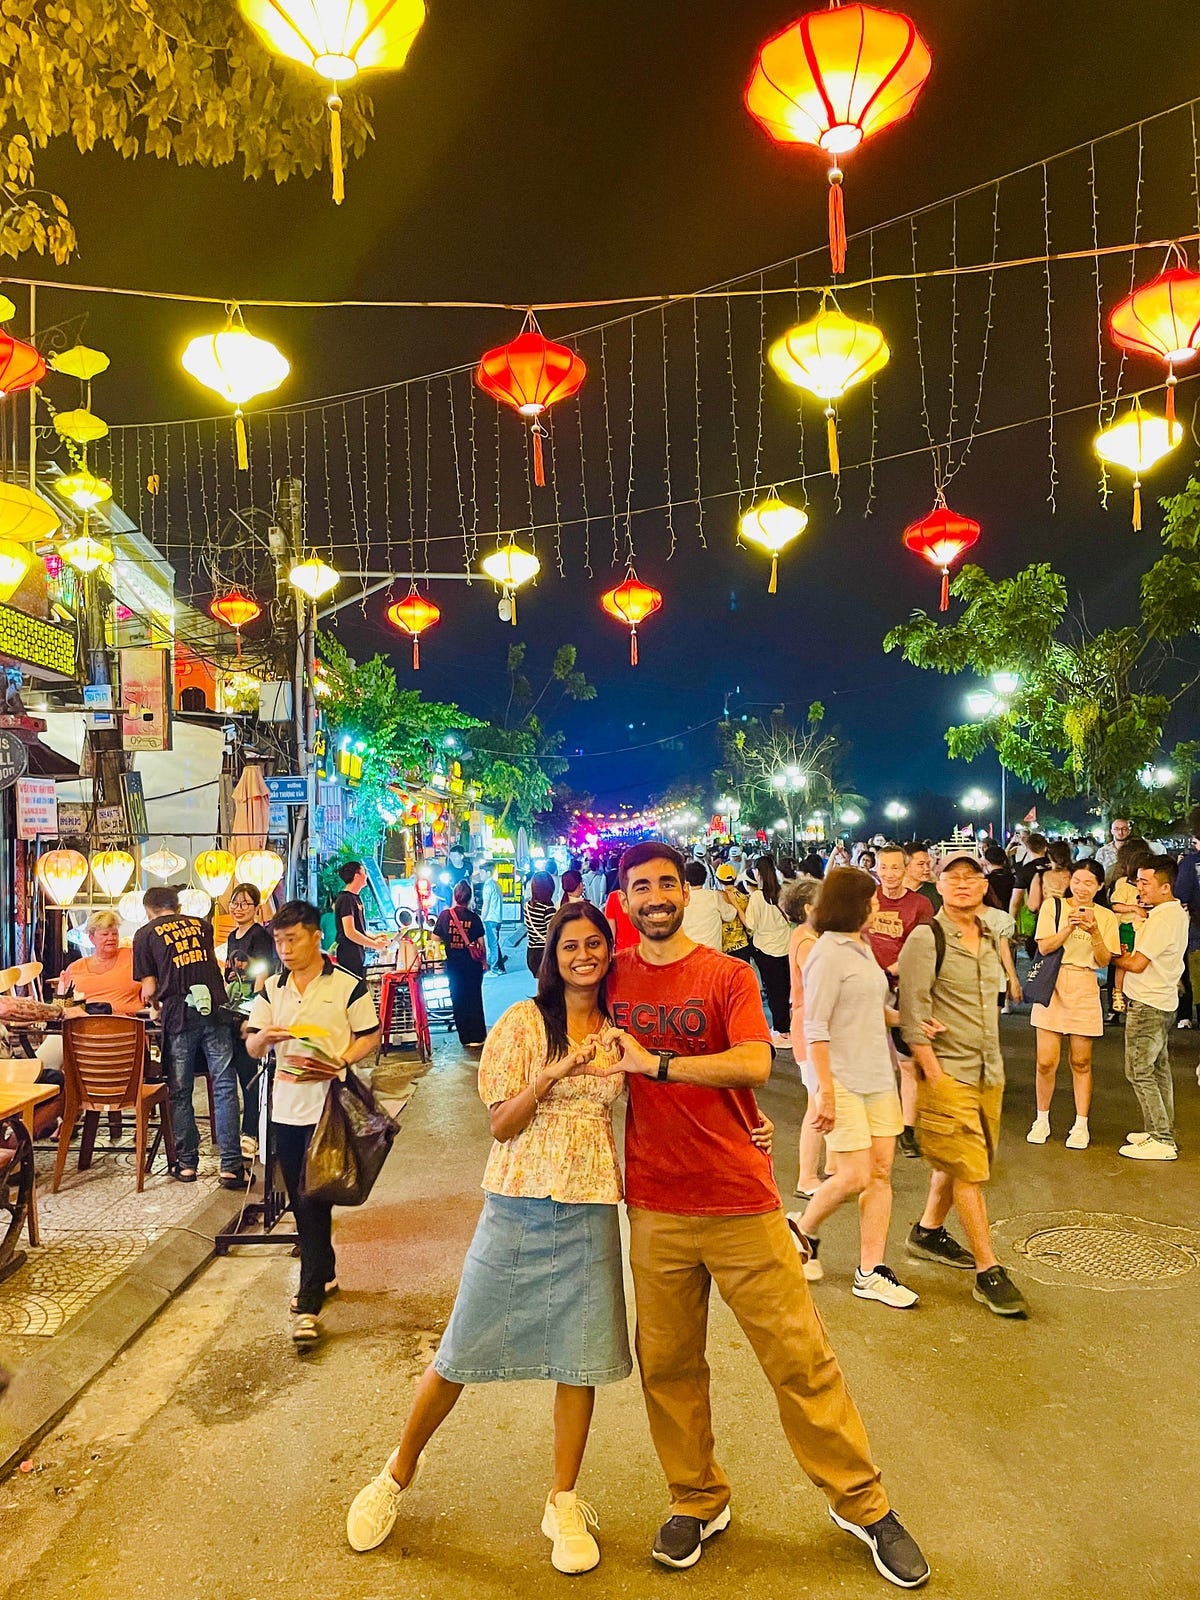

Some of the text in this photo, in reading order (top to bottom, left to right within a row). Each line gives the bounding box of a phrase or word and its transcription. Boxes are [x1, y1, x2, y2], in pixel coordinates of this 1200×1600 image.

[163, 933, 174, 946] A
[174, 936, 201, 953] BE A
